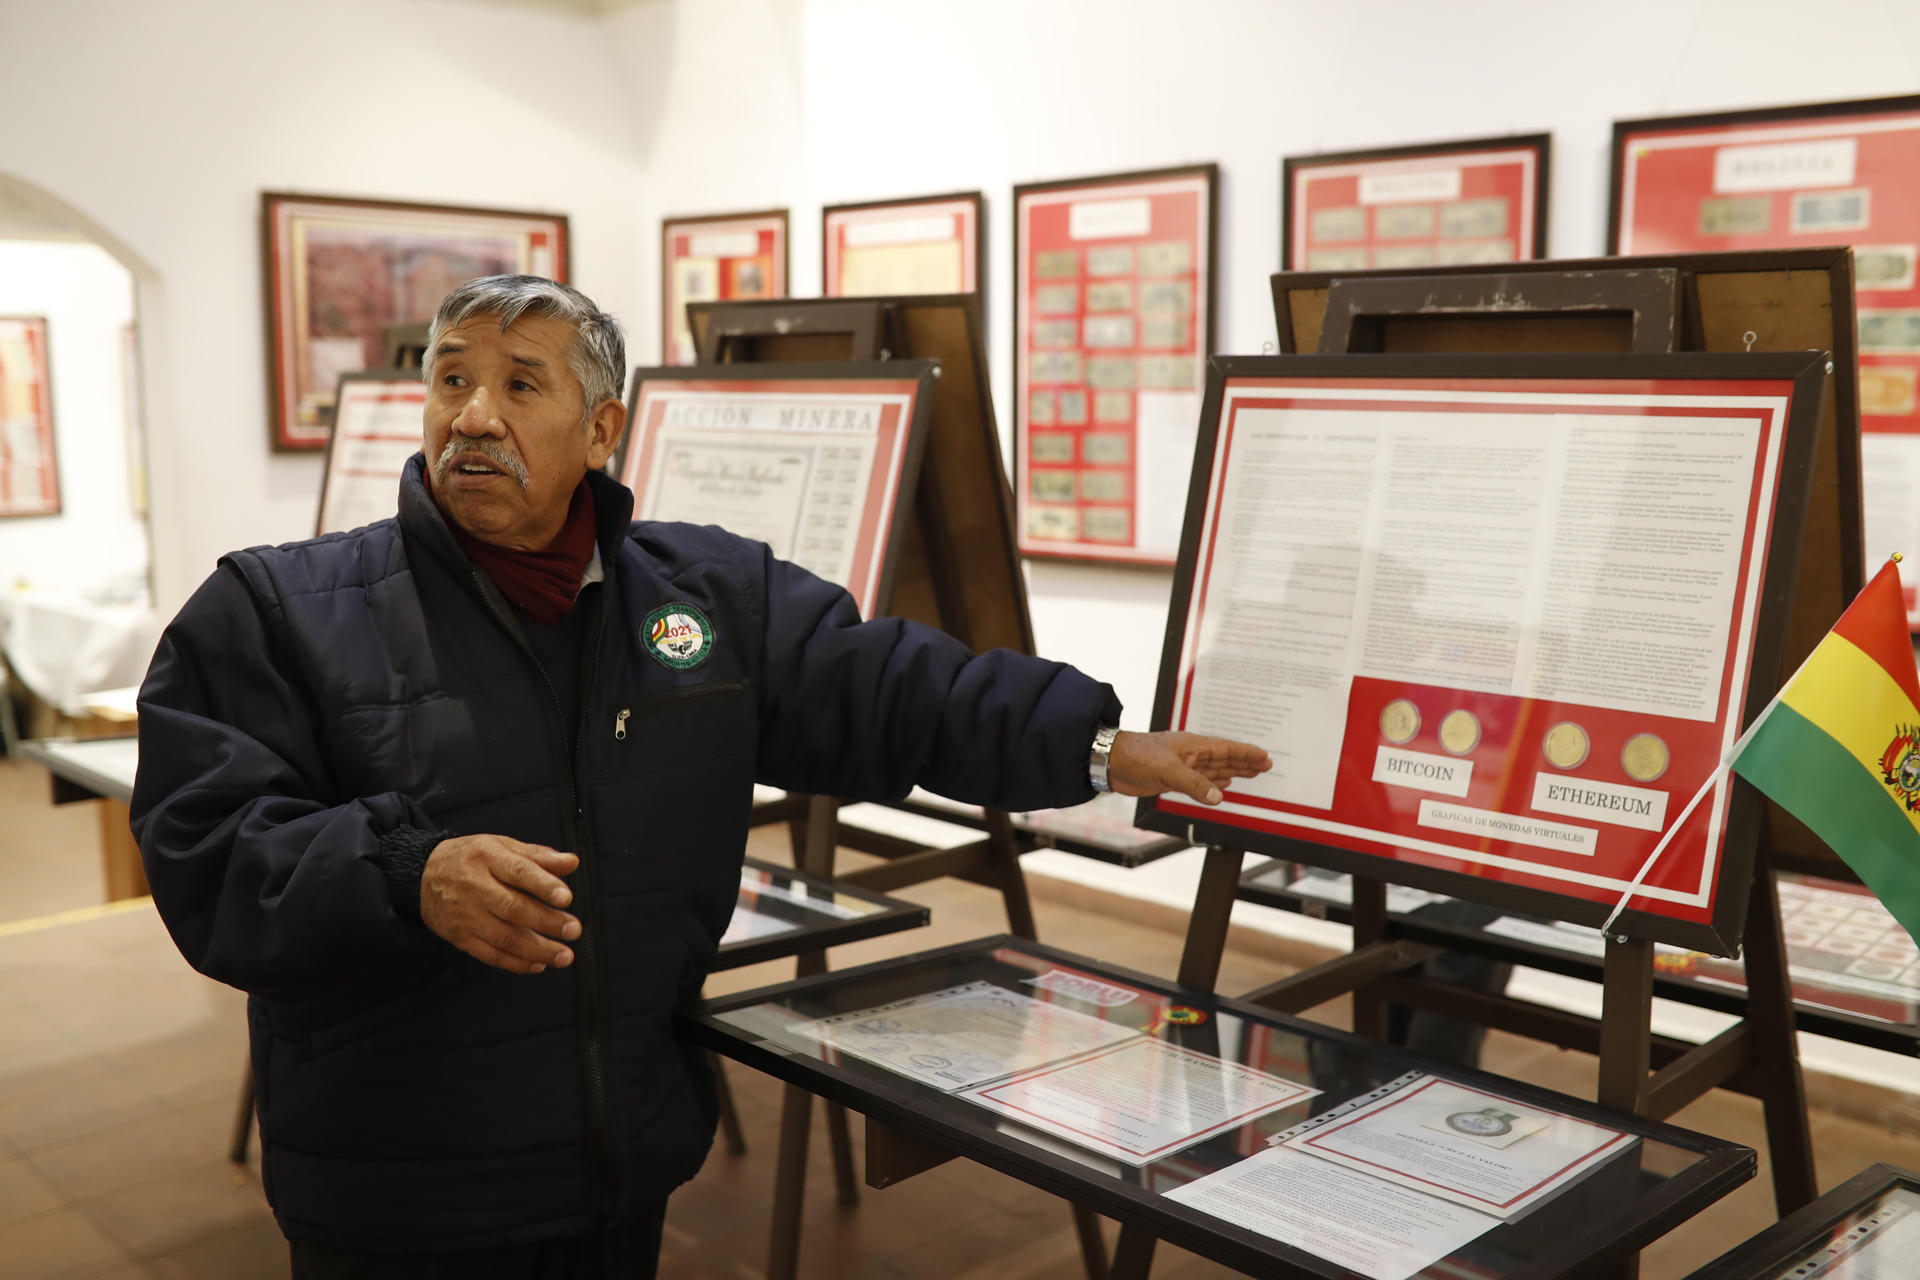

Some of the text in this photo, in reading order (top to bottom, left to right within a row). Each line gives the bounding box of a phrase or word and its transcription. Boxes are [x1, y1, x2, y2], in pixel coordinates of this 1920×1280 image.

[777, 407, 873, 430] MINERA
[664, 624, 692, 638] 2021
[1386, 758, 1454, 781] BITCOIN
[1547, 785, 1653, 816] ETHEREUM
[1431, 809, 1585, 843] GRAFICAS DE MONEDAS VIRTUALES
